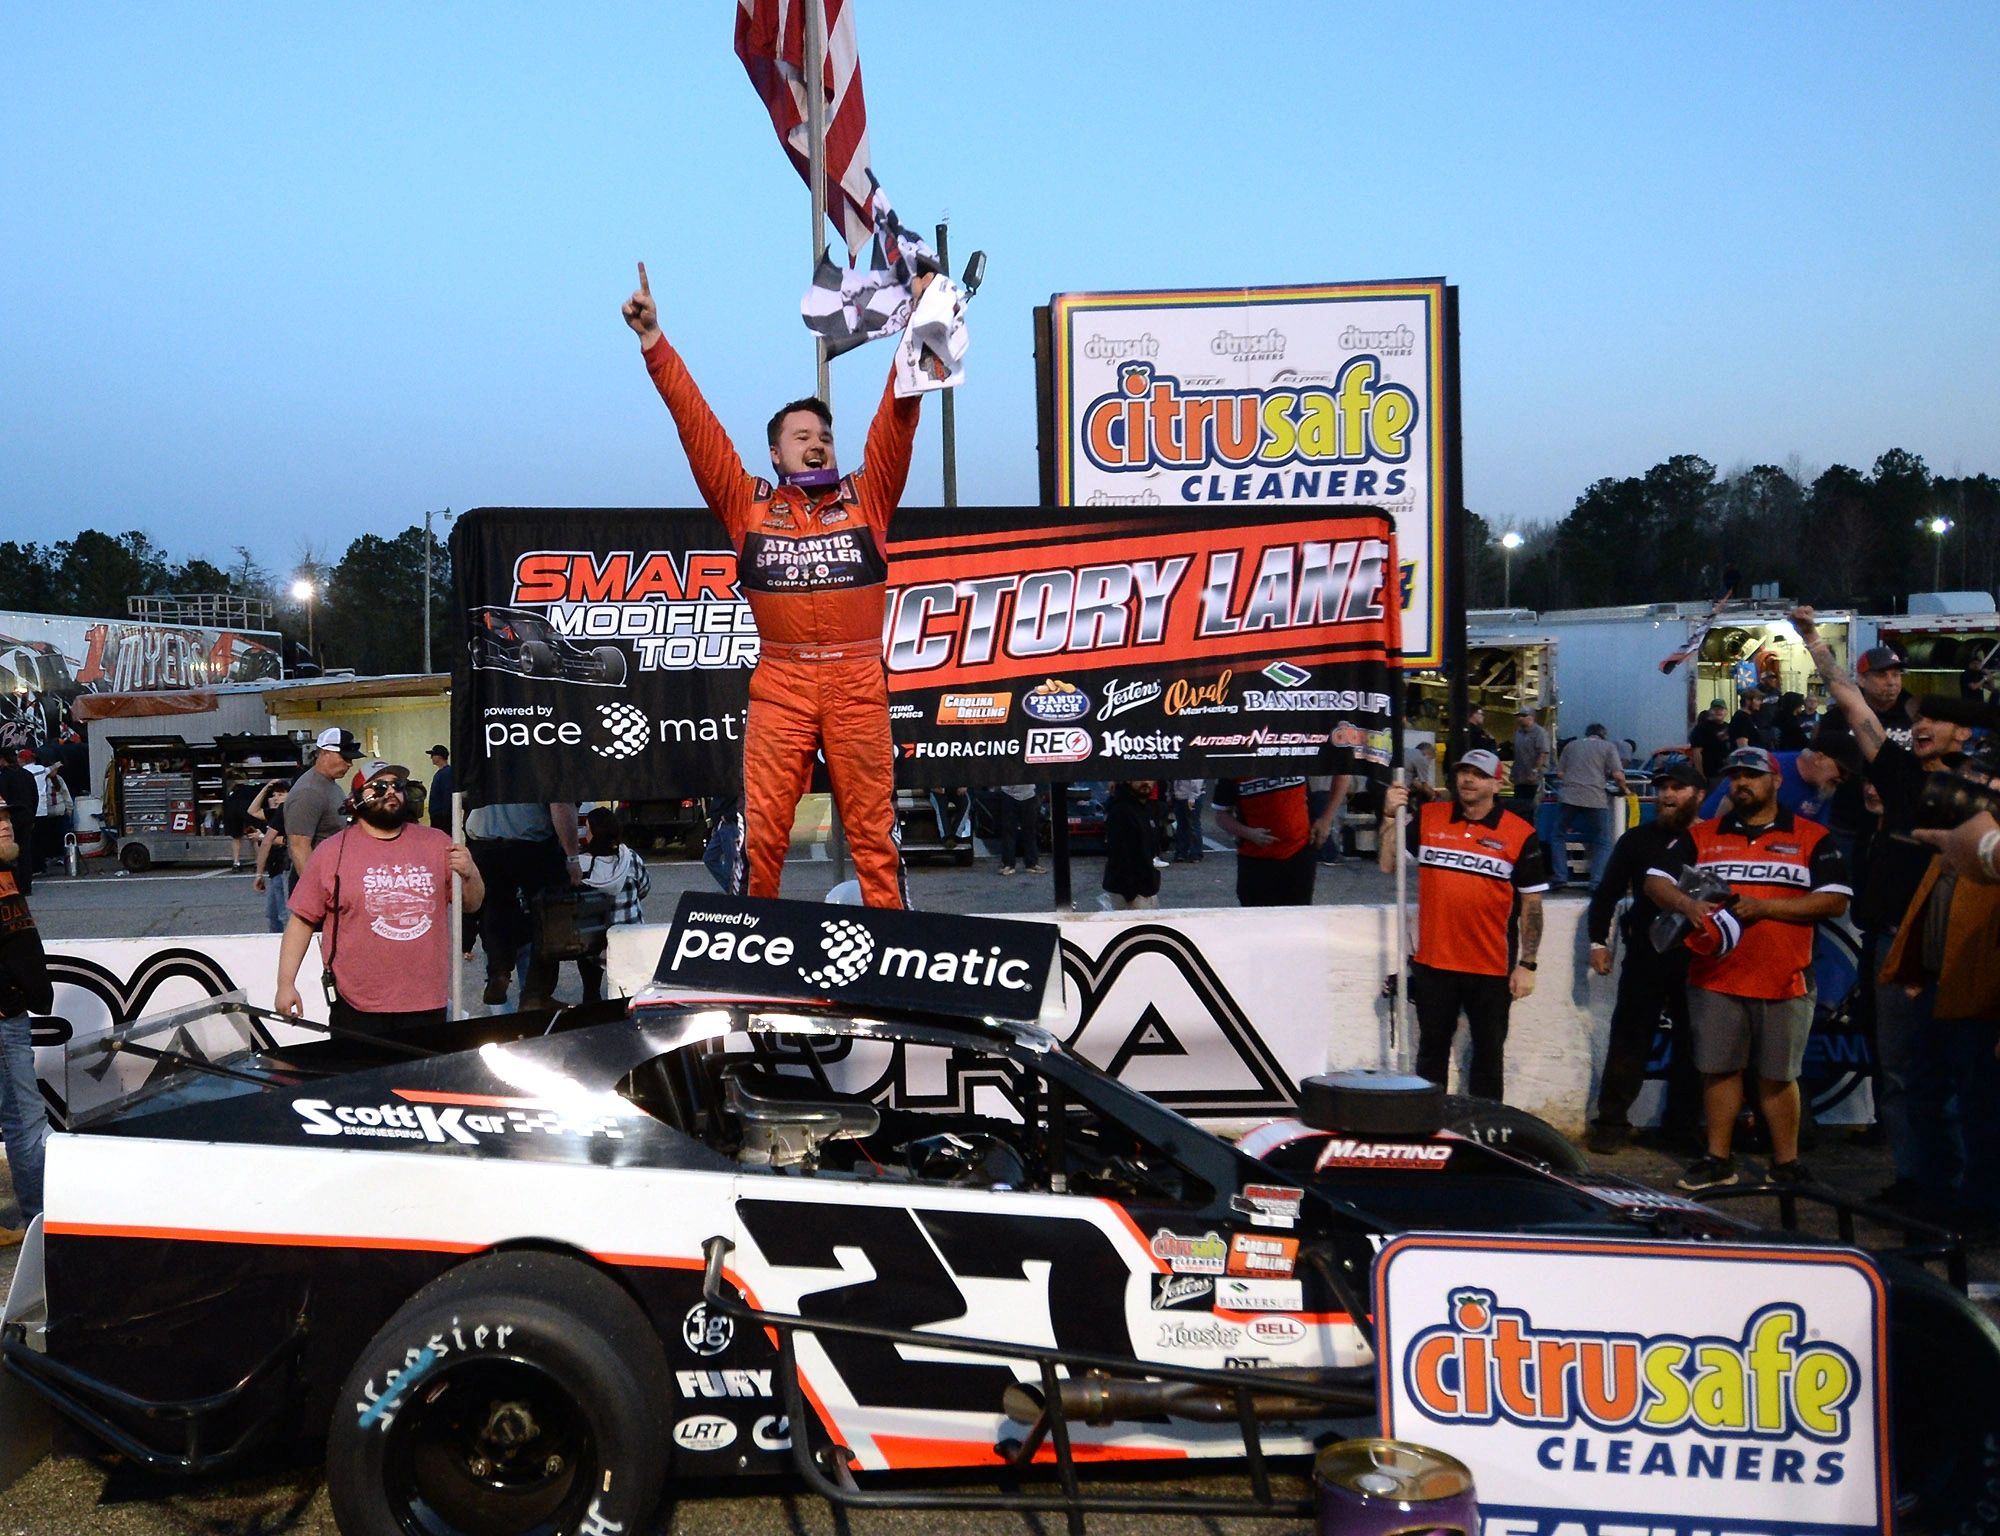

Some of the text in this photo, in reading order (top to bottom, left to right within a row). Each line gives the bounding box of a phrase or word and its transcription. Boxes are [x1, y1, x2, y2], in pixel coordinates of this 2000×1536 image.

[1088, 359, 1414, 466] citrusafe
[1181, 469, 1406, 502] CLEANERS
[763, 535, 853, 554] ATLANTIC
[757, 549, 862, 567] SPRINKLER
[513, 551, 746, 605] SMAR
[766, 575, 854, 587] CORPORATION
[1202, 539, 1390, 637] LANE
[636, 635, 760, 670] TOUR
[944, 695, 994, 707] CAROLINA
[1030, 695, 1083, 705] PEANUT
[1164, 668, 1233, 716] Oval
[484, 705, 553, 718] powered by
[957, 706, 1006, 718] DRILLING
[1036, 703, 1081, 714] PATCH
[1179, 704, 1238, 716] Marketing
[485, 721, 582, 758] pace
[916, 739, 1020, 759] FLORACING
[1099, 728, 1184, 758] Hoosier
[1424, 849, 1505, 875] OFFICIAL
[363, 872, 434, 889] SMART
[688, 910, 760, 928] powered by
[671, 928, 1030, 990] pace matic
[292, 1099, 418, 1136] Scott
[344, 1126, 424, 1140] ENGINEERING
[1316, 1139, 1453, 1168] MARTINO
[1174, 1258, 1223, 1267] CLEANERS
[1156, 1320, 1242, 1348] Hoosier
[1255, 1323, 1299, 1335] BELL
[1412, 1306, 1852, 1435] citrusafe
[675, 1369, 773, 1398] FURY
[680, 1422, 727, 1440] LRT
[1537, 1437, 1845, 1486] CLEANERS
